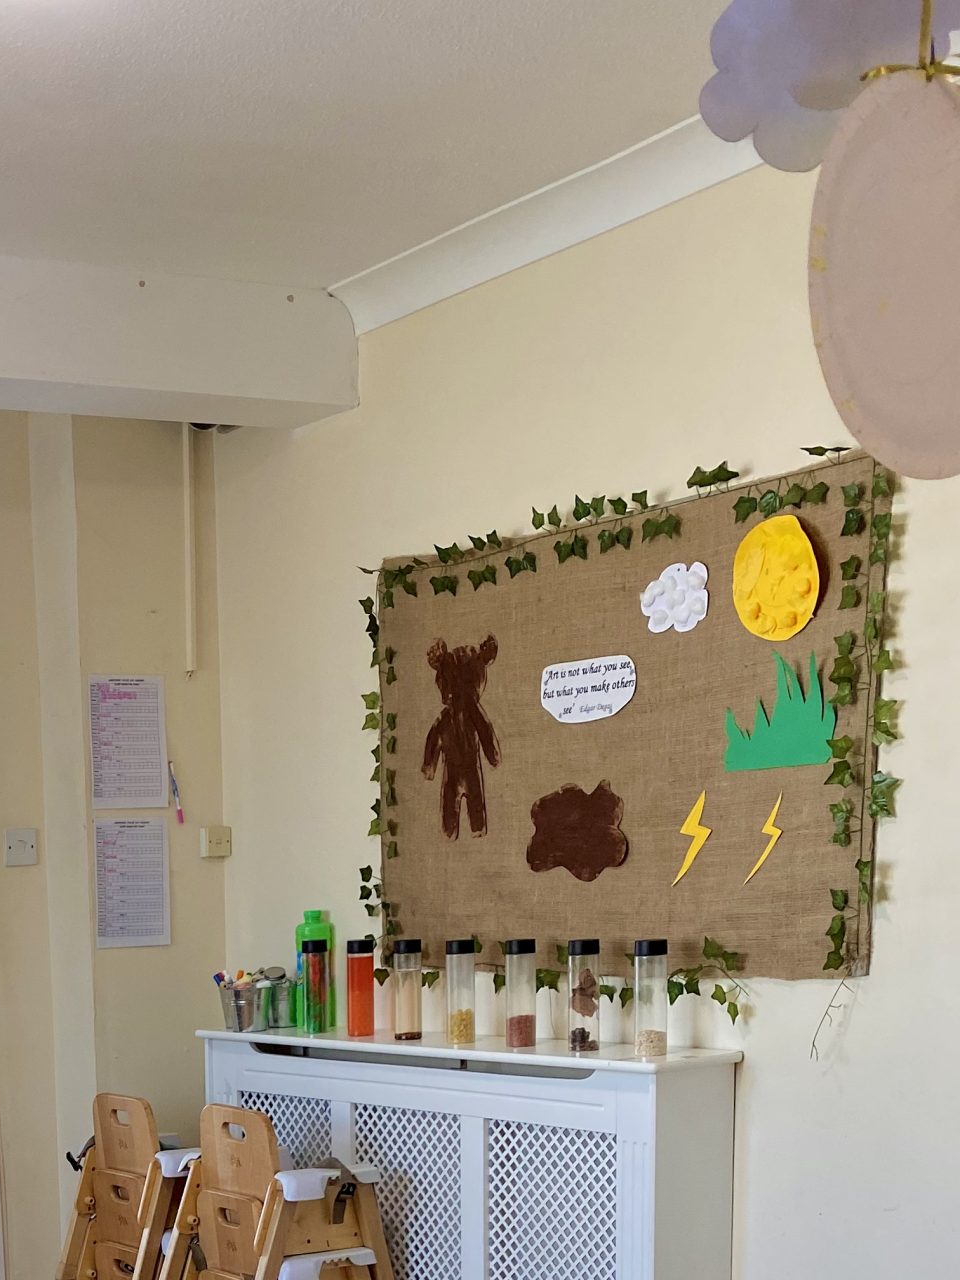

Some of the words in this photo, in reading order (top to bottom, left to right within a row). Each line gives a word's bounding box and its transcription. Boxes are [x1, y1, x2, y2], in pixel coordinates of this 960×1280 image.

[561, 668, 567, 679] is
[568, 667, 580, 678] not
[582, 662, 601, 675] what
[602, 663, 618, 676] you
[543, 687, 555, 699] but
[556, 685, 574, 698] what
[574, 686, 589, 699] you
[590, 679, 611, 694] make
[611, 676, 635, 690] others
